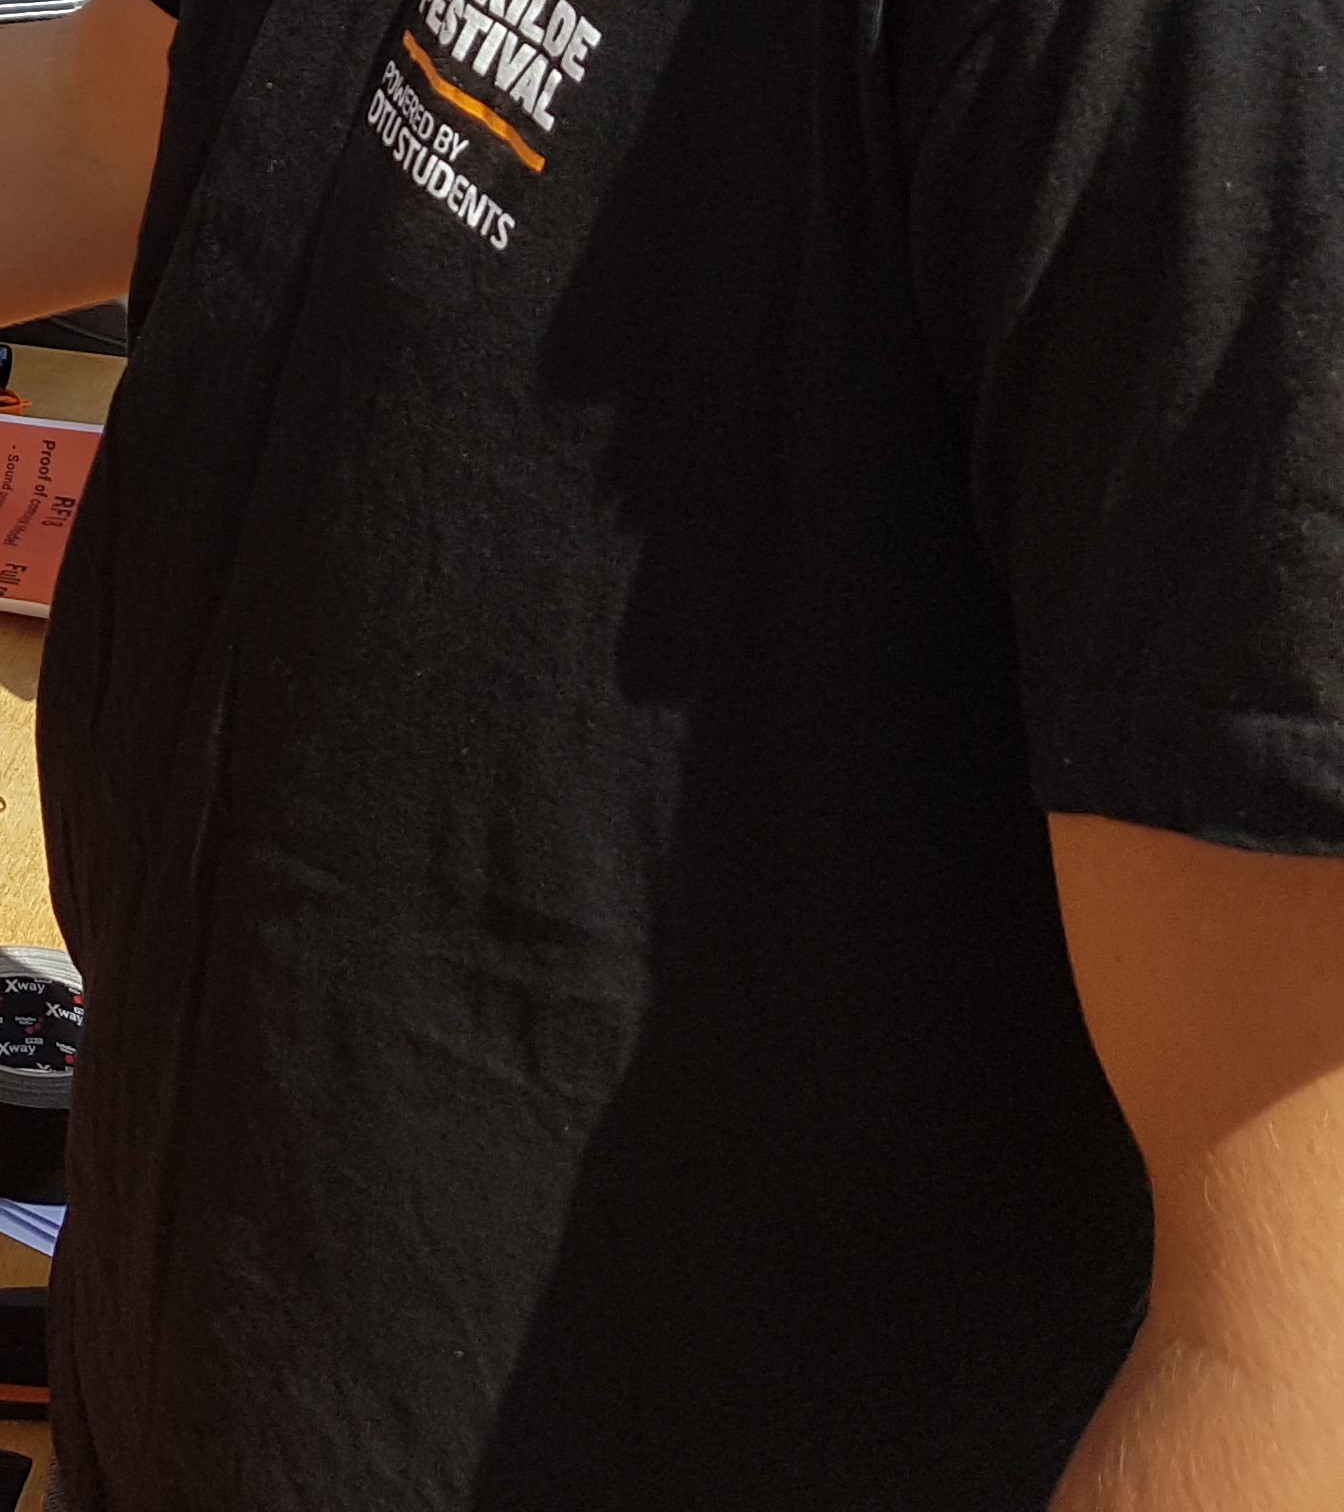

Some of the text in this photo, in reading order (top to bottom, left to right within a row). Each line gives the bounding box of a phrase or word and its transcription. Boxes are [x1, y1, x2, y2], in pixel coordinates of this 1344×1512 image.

[381, 60, 470, 161] POWERED BY
[2, 454, 19, 492] Sound
[37, 439, 56, 483] Proof
[33, 484, 48, 498] of
[4, 979, 46, 994] Xway
[45, 1001, 84, 1026] Xway
